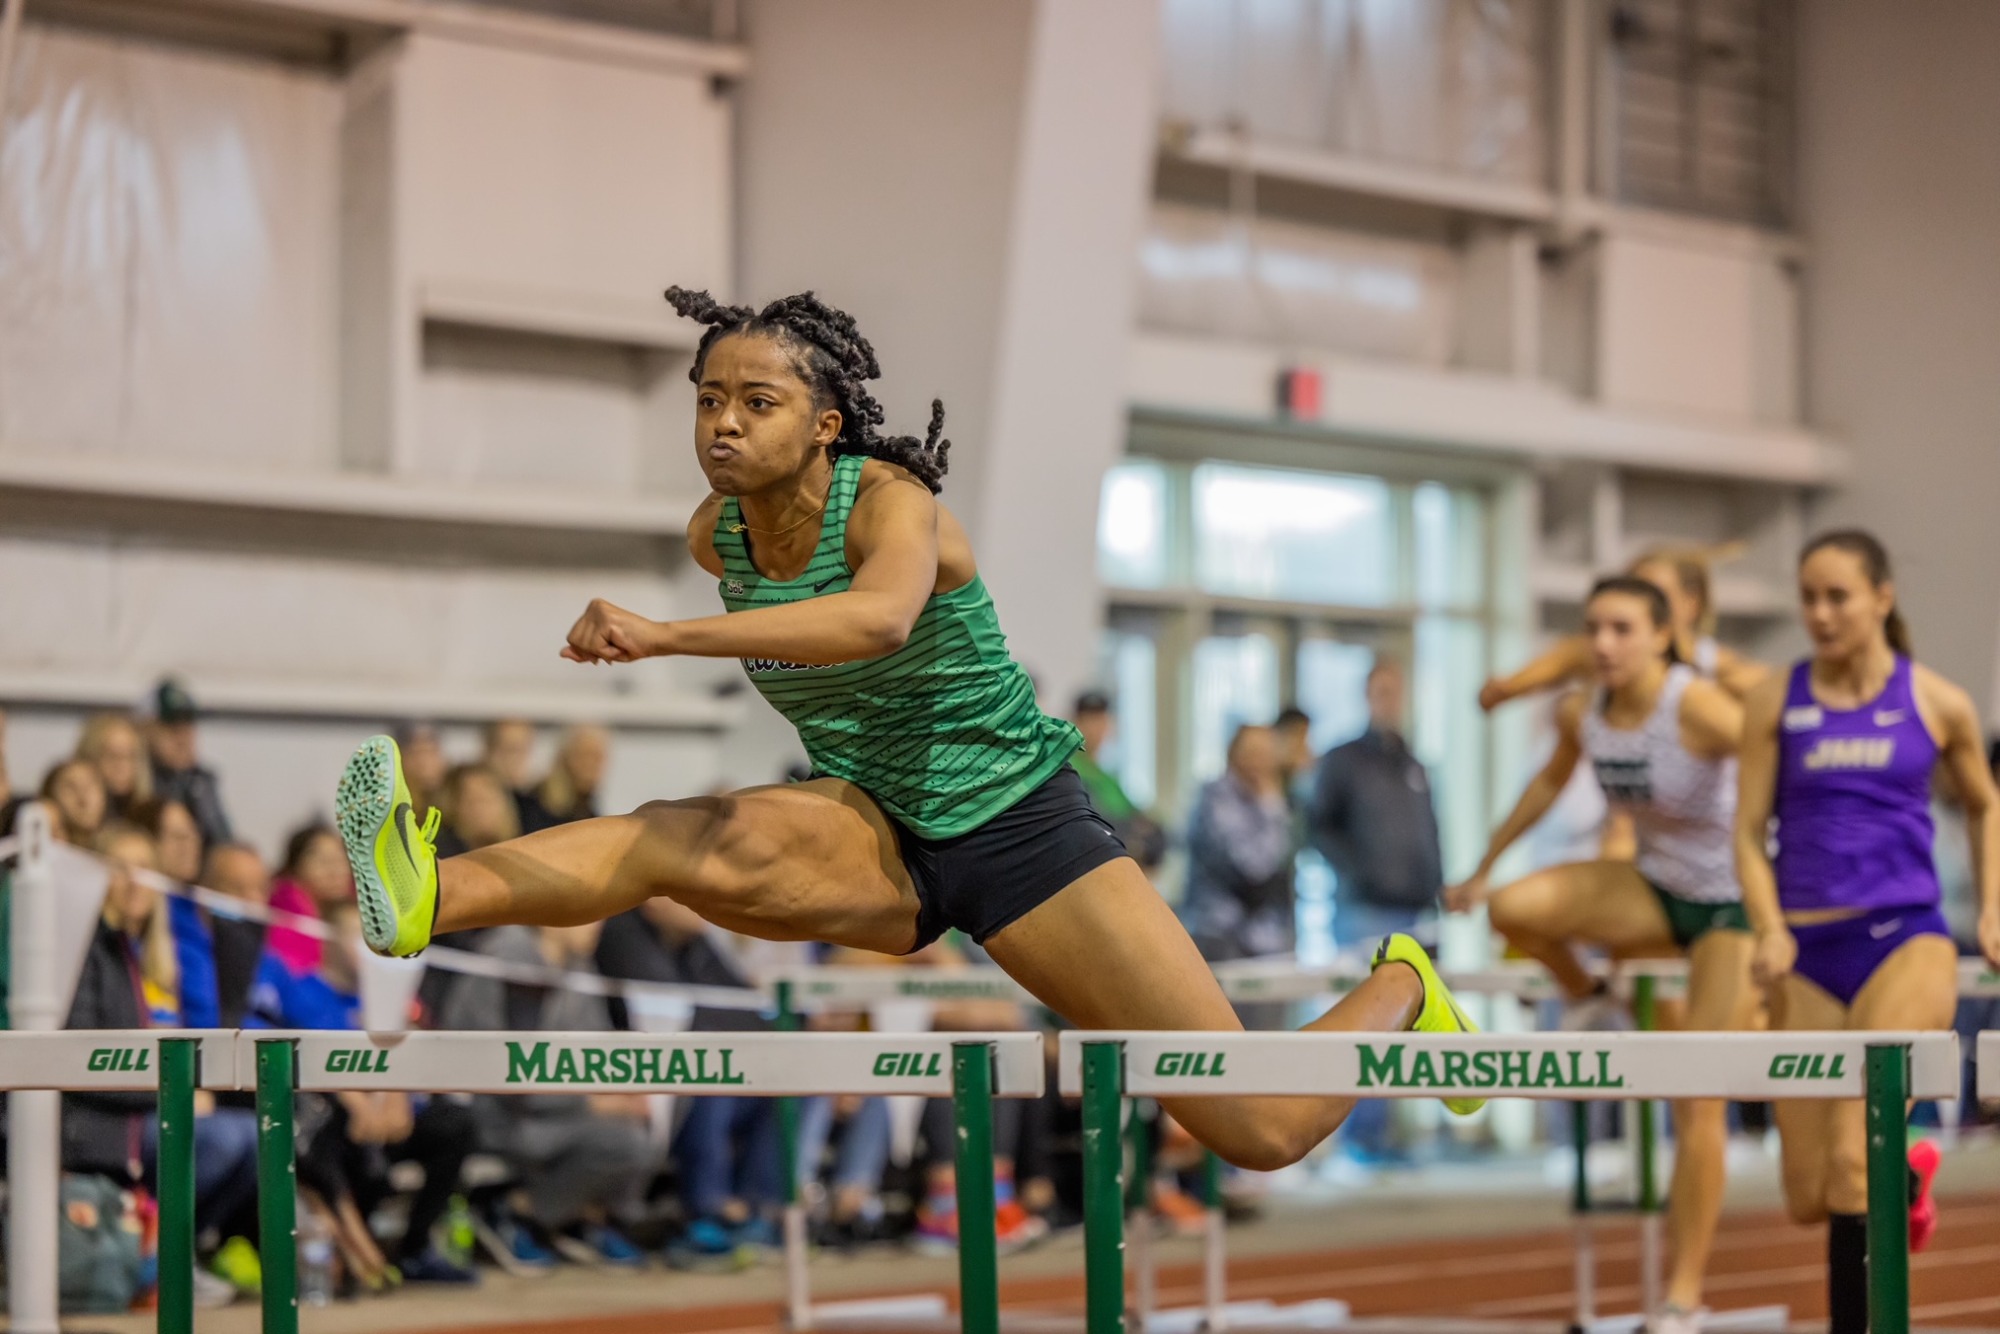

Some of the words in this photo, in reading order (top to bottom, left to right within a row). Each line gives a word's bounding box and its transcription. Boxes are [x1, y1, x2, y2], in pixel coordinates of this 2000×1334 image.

[1803, 736, 1895, 770] JMU
[89, 1049, 148, 1071] GILL
[326, 1050, 388, 1073] GILL
[507, 1042, 744, 1085] MARSHALL
[874, 1053, 940, 1077] GILL
[1156, 1053, 1224, 1077] GILL
[1359, 1044, 1624, 1088] MARSHALL
[1770, 1055, 1843, 1078] GILL
